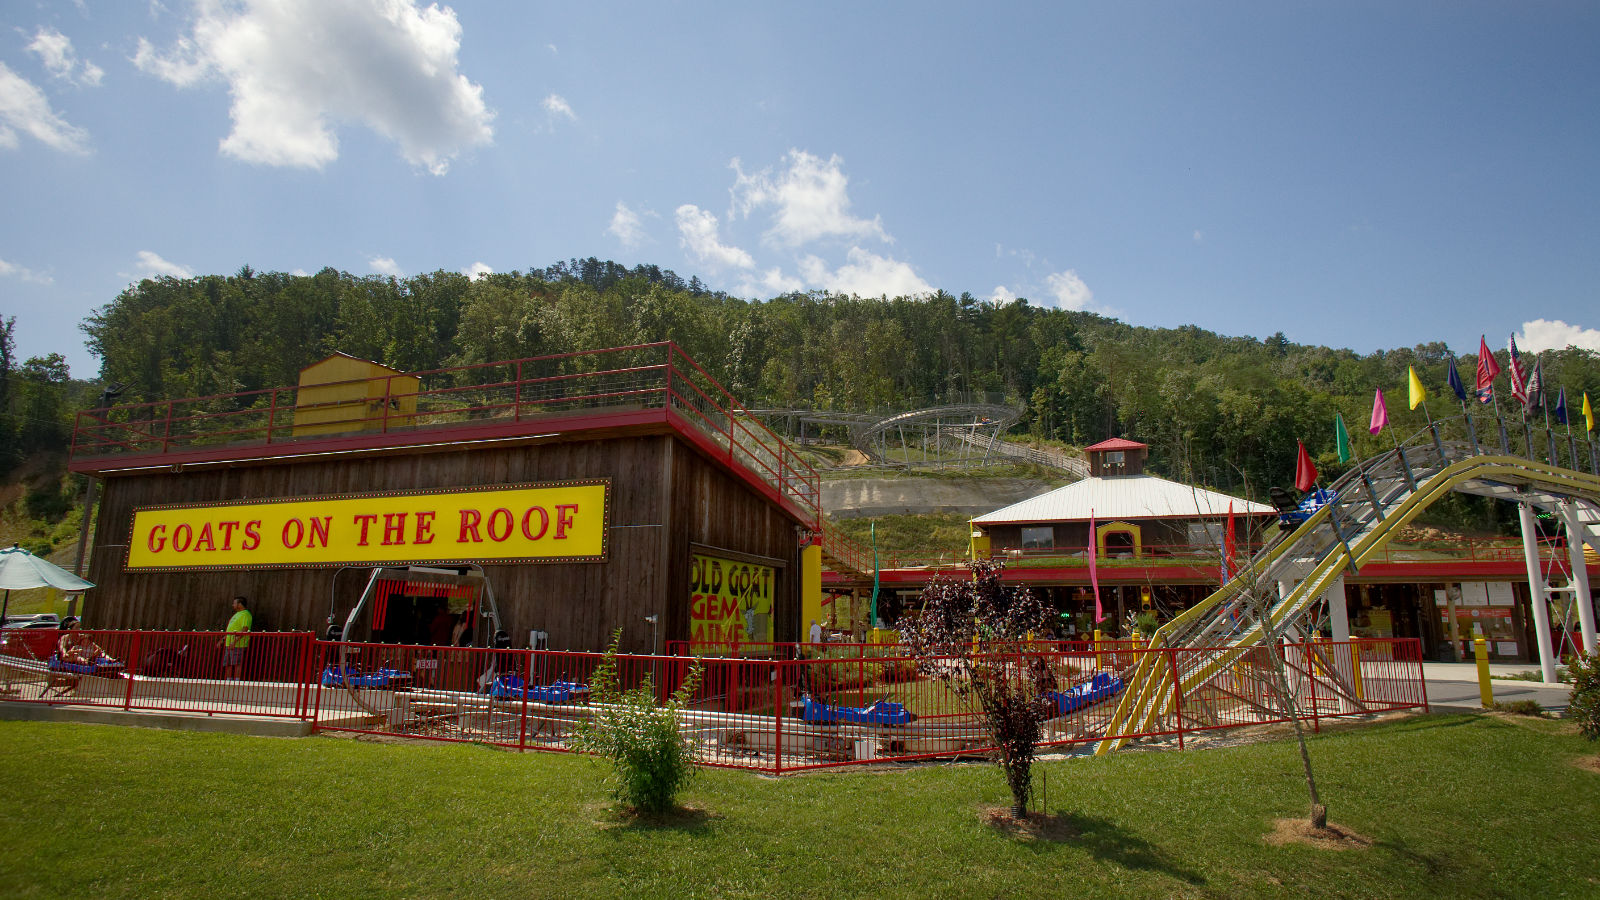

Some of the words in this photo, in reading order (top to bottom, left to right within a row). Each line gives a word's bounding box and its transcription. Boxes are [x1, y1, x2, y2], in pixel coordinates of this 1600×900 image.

[147, 520, 262, 553] GOATS
[282, 516, 333, 549] ON
[354, 511, 436, 546] THE
[457, 503, 580, 543] ROOF
[728, 565, 770, 599] GOAT
[691, 594, 740, 621] GEM
[690, 623, 744, 649] MINE
